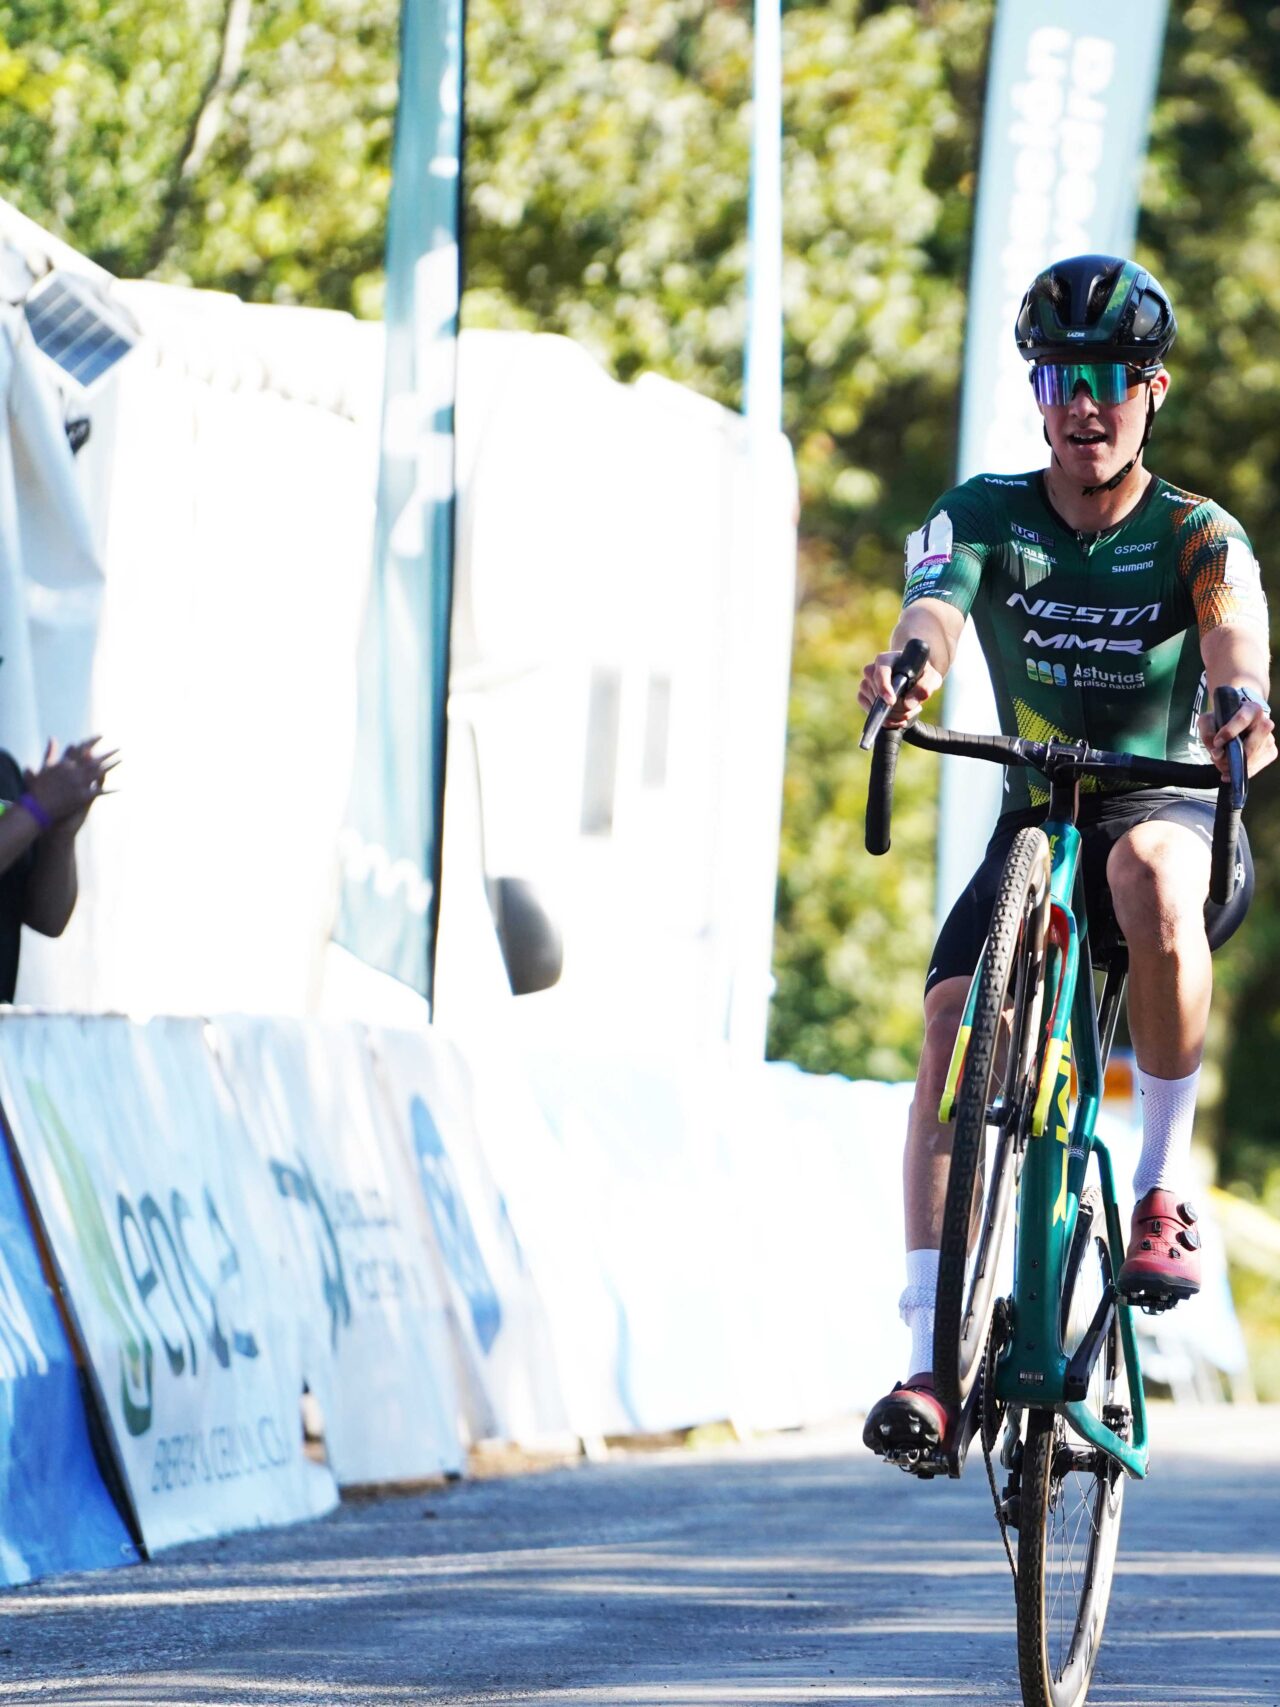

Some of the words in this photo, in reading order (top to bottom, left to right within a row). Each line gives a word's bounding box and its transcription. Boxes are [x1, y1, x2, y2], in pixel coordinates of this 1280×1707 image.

[984, 477, 1028, 487] MMR
[922, 522, 931, 553] 1
[1015, 525, 1038, 541] UCI
[1114, 540, 1159, 555] GSPORT
[1111, 560, 1154, 573] SHIMANO
[1006, 593, 1161, 626] NESTA
[1022, 630, 1144, 655] MMR
[1073, 663, 1145, 683] Asturias
[1108, 681, 1146, 690] natural
